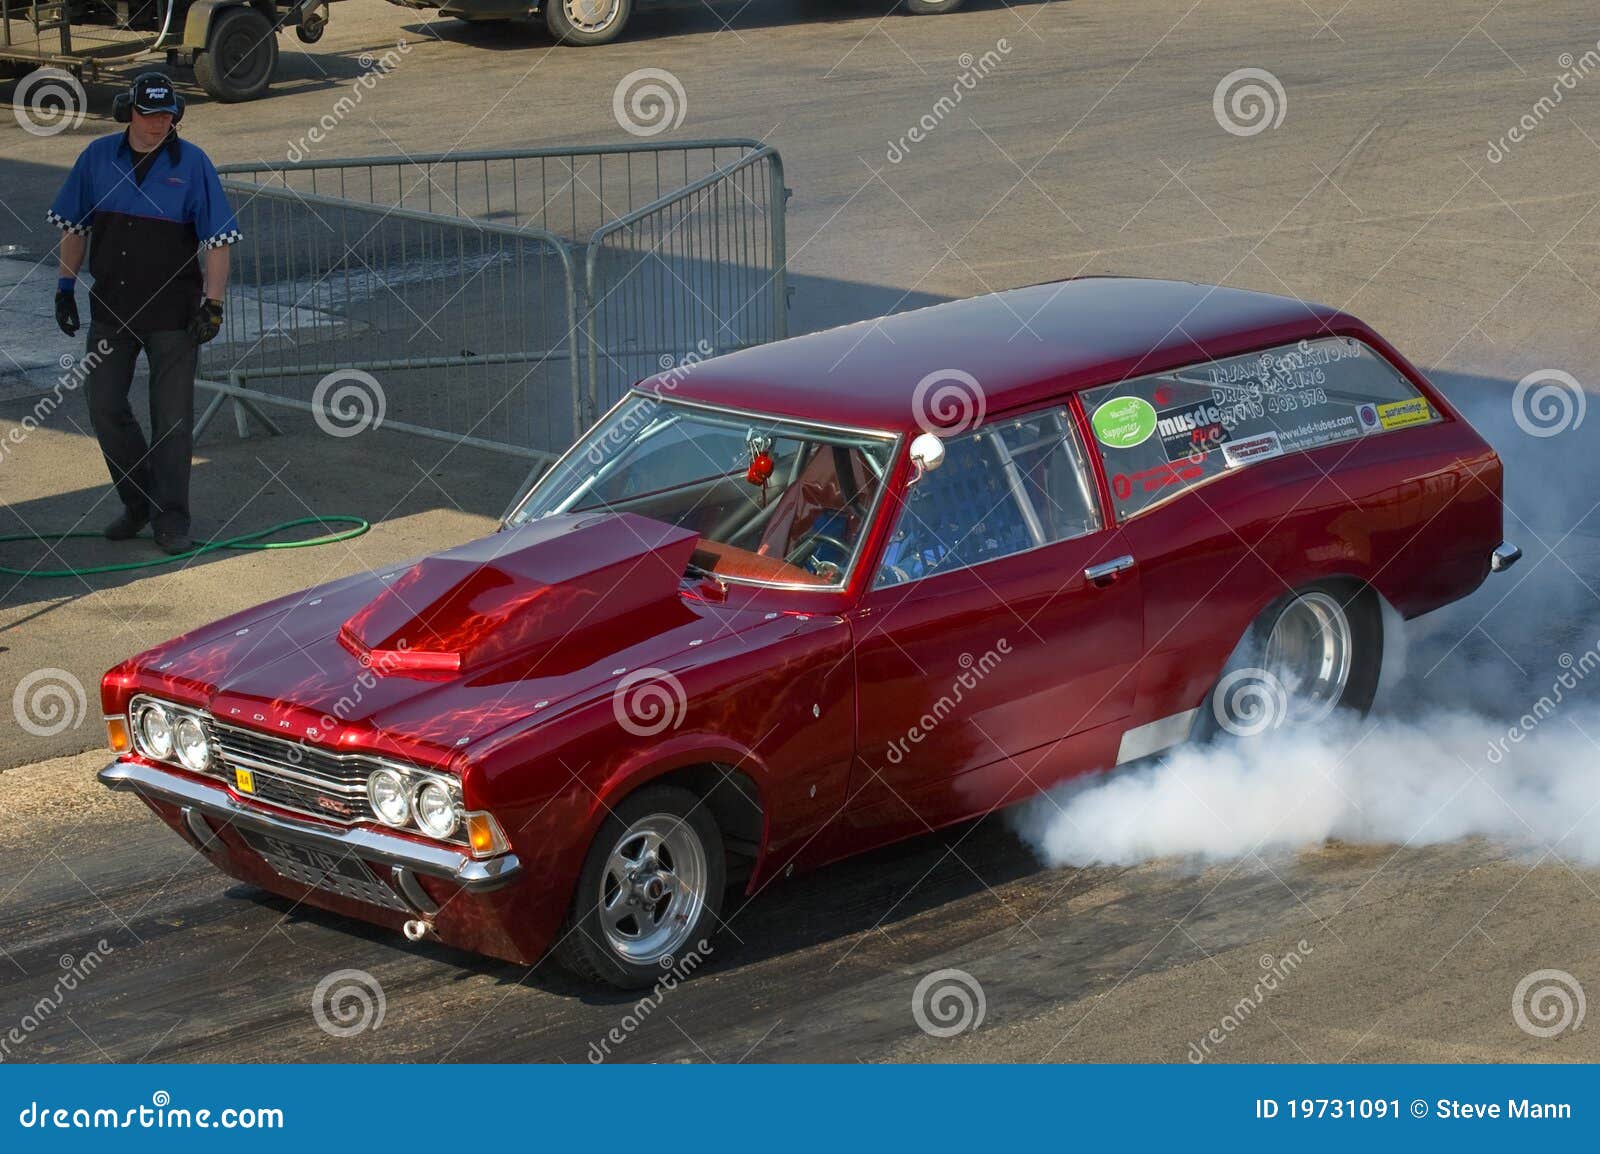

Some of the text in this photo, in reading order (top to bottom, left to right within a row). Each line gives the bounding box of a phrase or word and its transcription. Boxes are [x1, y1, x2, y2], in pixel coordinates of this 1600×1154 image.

[1212, 368, 1325, 406] DRAG RACING
[1268, 394, 1298, 414] 403
[1299, 388, 1327, 408] 378
[1102, 422, 1138, 440] Supporter
[1157, 405, 1220, 437] muscle
[1278, 414, 1355, 441] www.led-tubes.com
[230, 707, 318, 735] FORD
